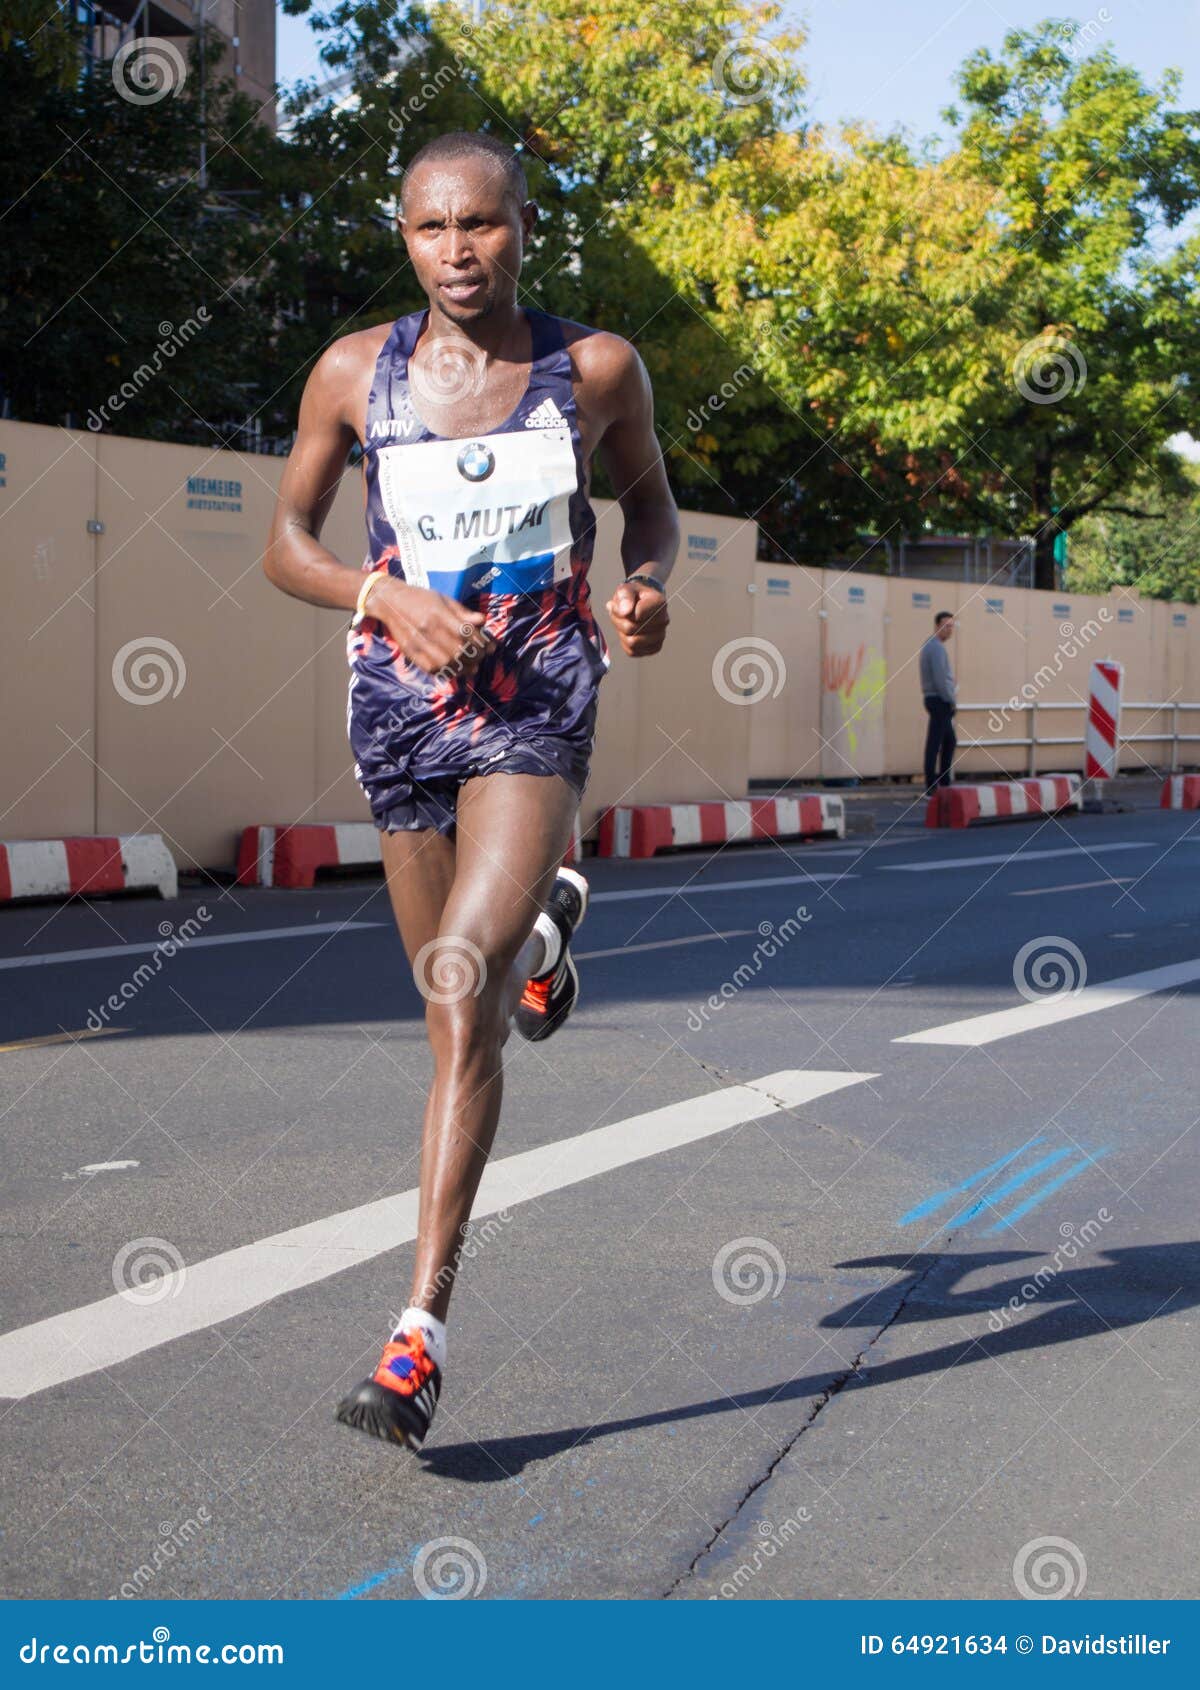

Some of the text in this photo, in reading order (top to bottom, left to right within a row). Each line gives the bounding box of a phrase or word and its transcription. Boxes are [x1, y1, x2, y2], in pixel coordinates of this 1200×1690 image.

[525, 416, 568, 429] adidas
[187, 477, 242, 498] NIEMEIER
[418, 514, 442, 541] G.
